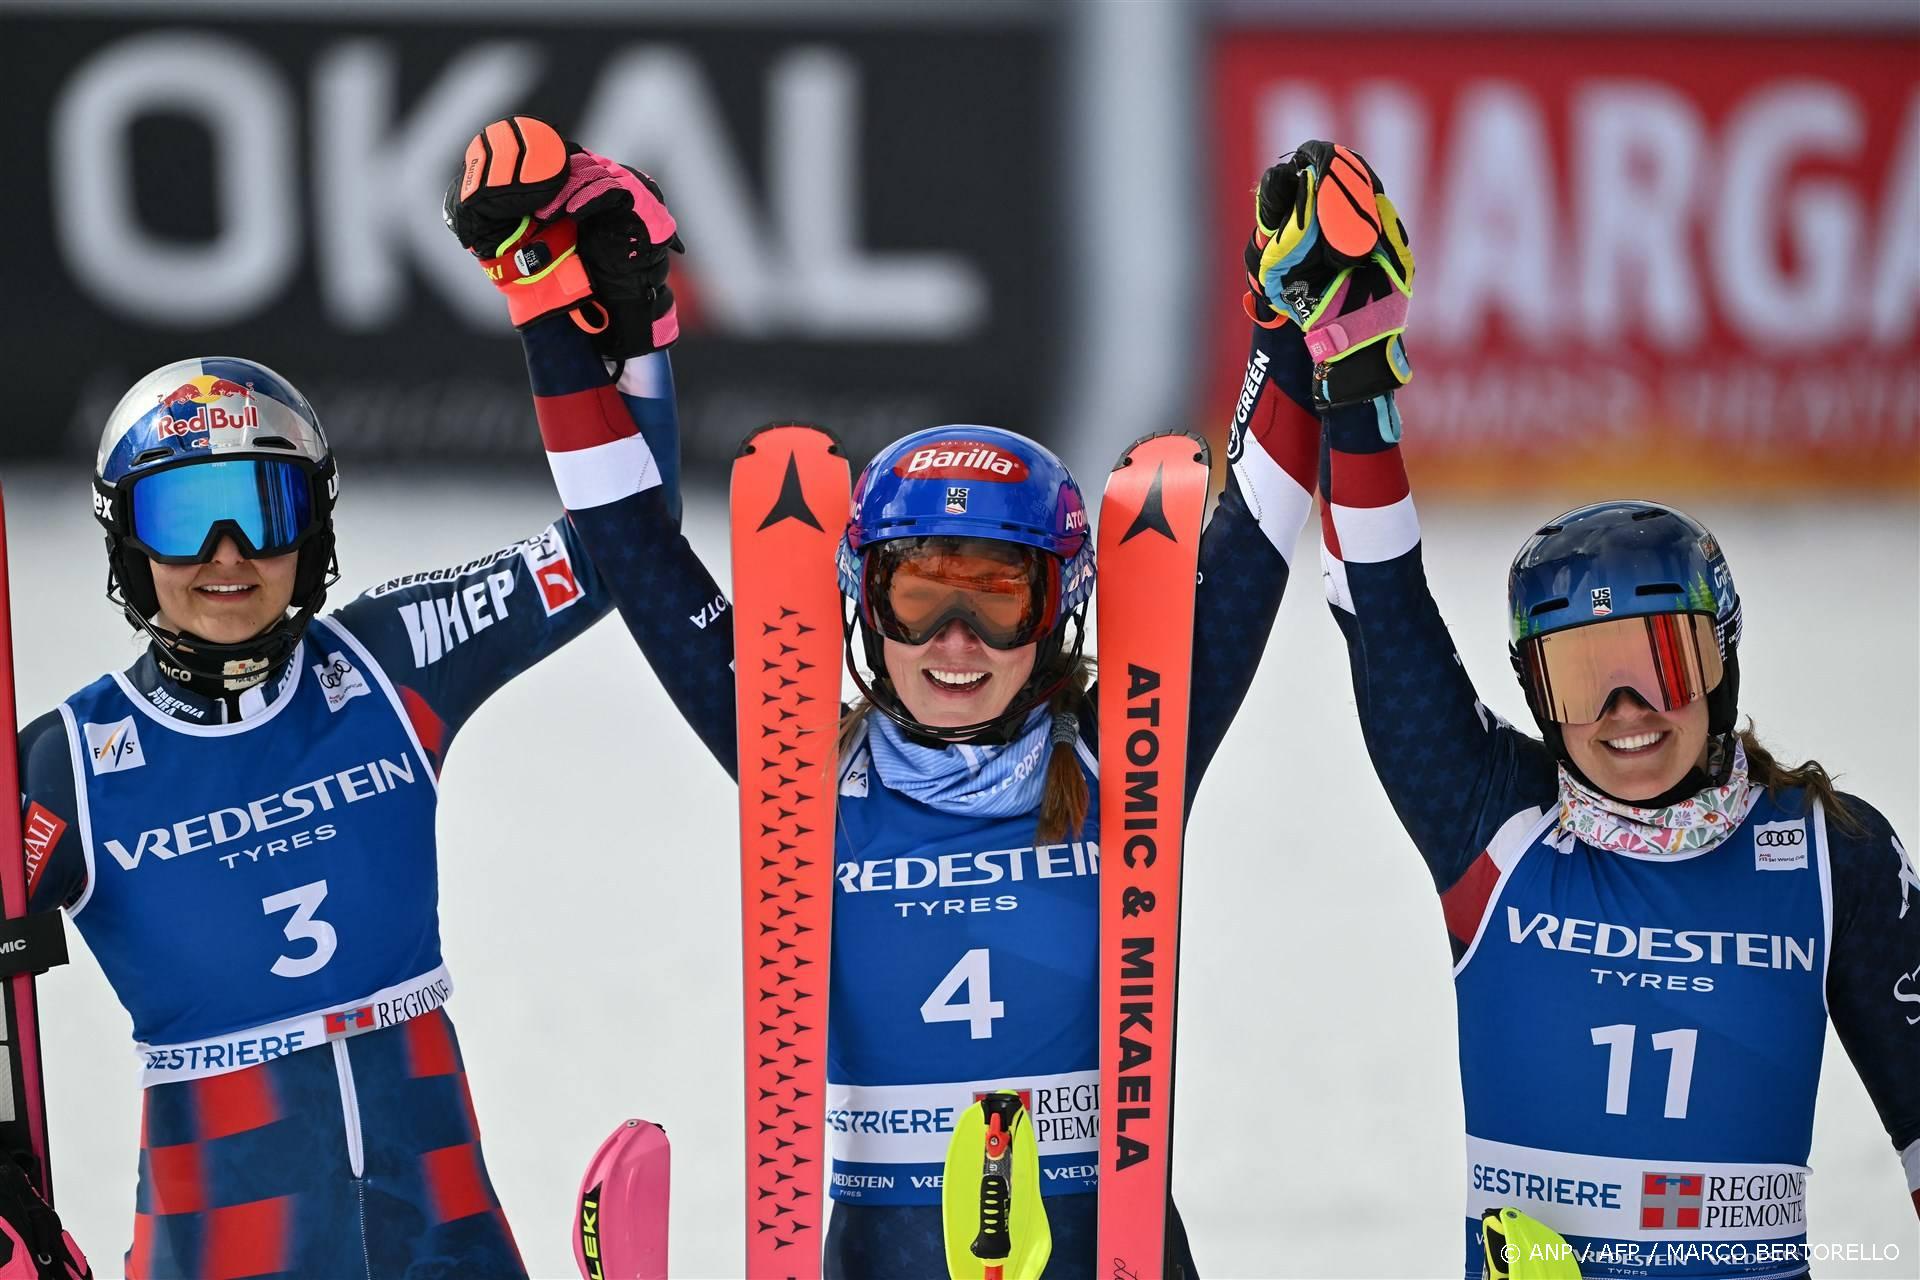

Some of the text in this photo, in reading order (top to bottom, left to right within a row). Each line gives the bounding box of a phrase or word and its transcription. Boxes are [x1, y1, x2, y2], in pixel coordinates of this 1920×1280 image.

[52, 30, 986, 335] OKAL
[1236, 349, 1271, 424] GREEN
[157, 406, 259, 441] Red Bull
[908, 449, 1014, 476] Barilla
[947, 487, 968, 498] US
[1592, 589, 1610, 599] US
[147, 691, 177, 716] PURA
[154, 686, 205, 719] ENERGIA
[103, 752, 416, 871] VREDESTEIN
[219, 823, 337, 869] TYRES
[836, 841, 1099, 894] REDESTEI
[261, 879, 338, 978] 3
[894, 896, 1018, 917] TYRES
[1115, 663, 1161, 1172] ATOMIC & MIKAELA
[1506, 906, 1815, 972] VREDESTEIN
[919, 948, 1005, 1039] 4
[1590, 968, 1715, 993] TYRES
[1590, 1023, 1698, 1119] 11
[1037, 1115, 1099, 1143] PIEM
[1473, 1163, 1622, 1210] SESTRIERE
[1707, 1172, 1805, 1202] REGIONE
[1704, 1200, 1802, 1228] PIEMONTE
[583, 1200, 604, 1280] LEKI
